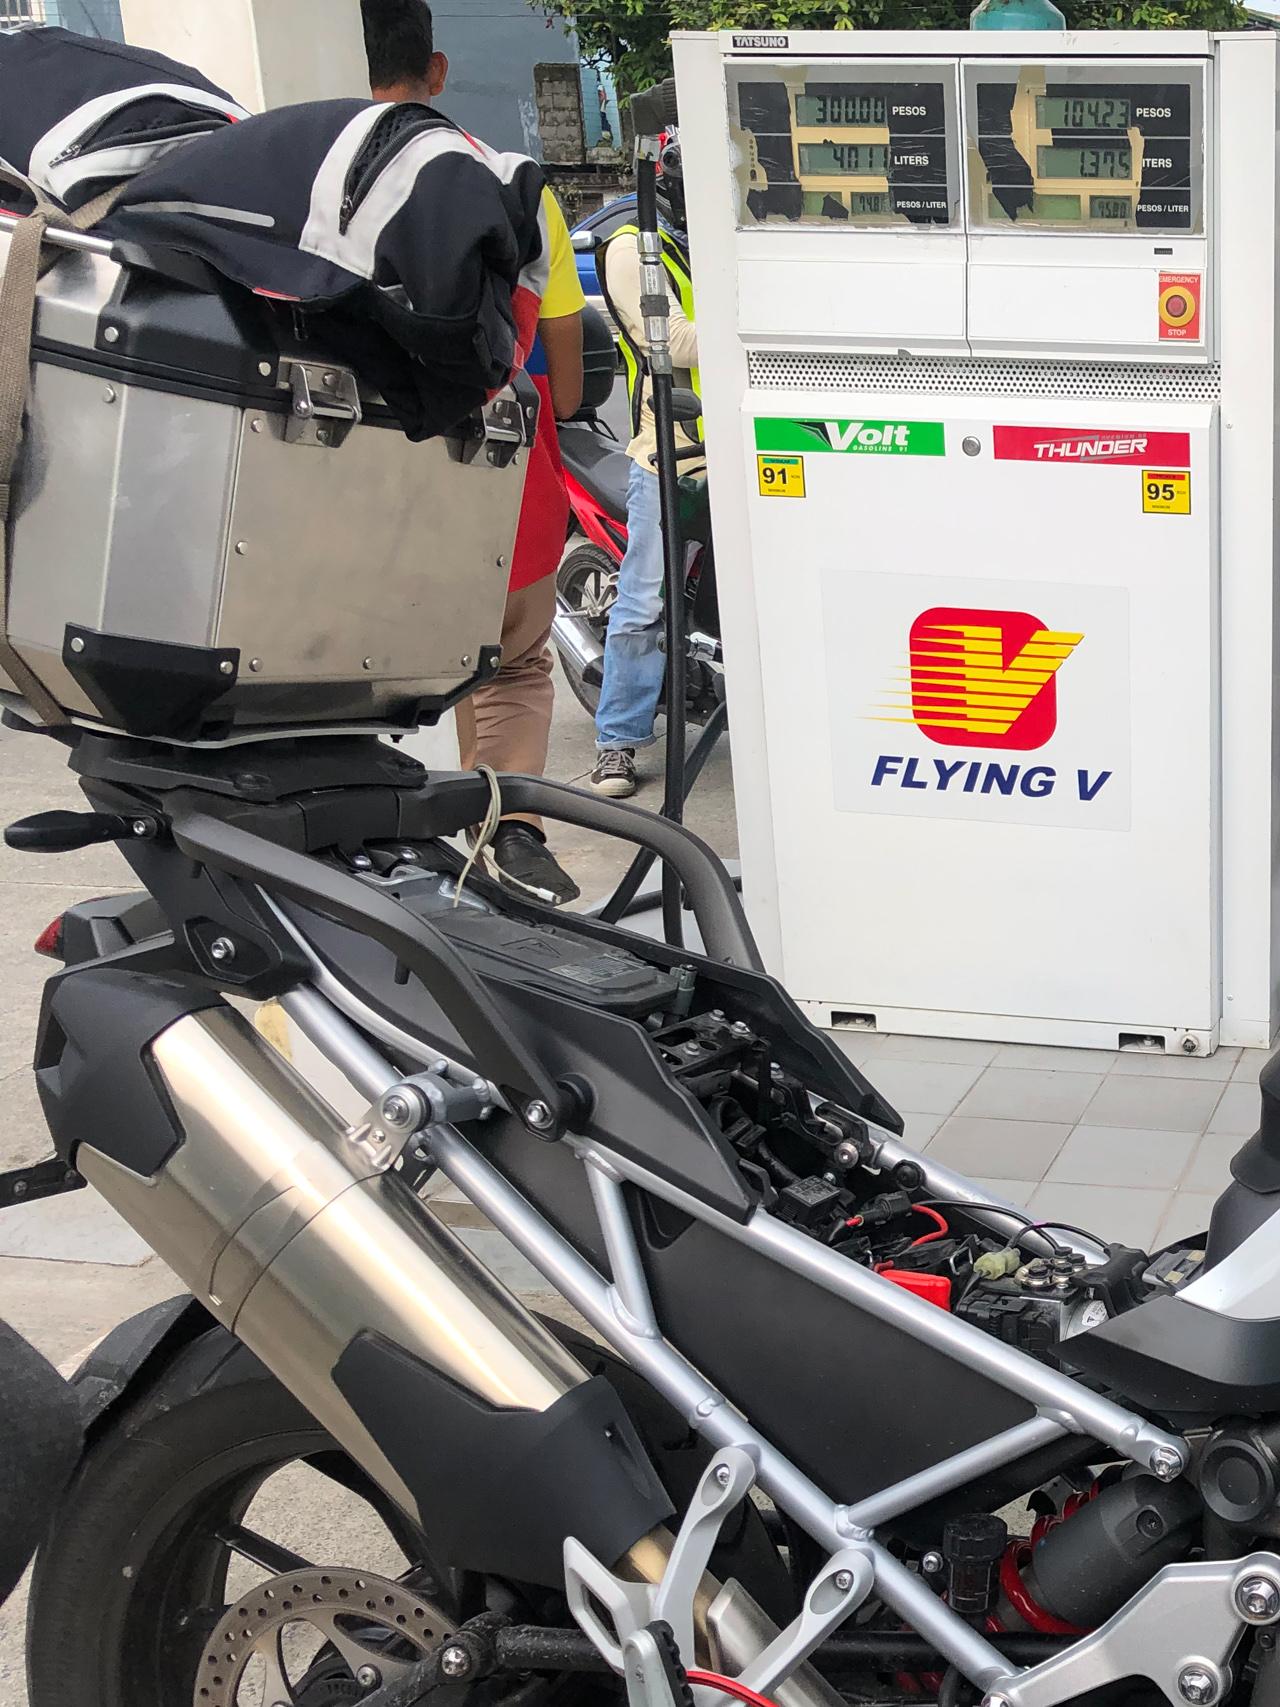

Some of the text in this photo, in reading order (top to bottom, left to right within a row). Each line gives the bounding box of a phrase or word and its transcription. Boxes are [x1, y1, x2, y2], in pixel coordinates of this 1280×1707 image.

[734, 36, 787, 48] TATSUNO
[892, 106, 927, 116] PESOS
[1136, 108, 1172, 118] PESOS
[894, 155, 929, 166] LITERS
[1142, 158, 1173, 168] ITERS
[896, 200, 921, 209] PESOS
[926, 201, 947, 209] LITER
[1137, 204, 1162, 212] PESOS
[1167, 205, 1189, 213] LITER
[1159, 275, 1199, 284] EMERGENCY
[1167, 328, 1187, 336] STOP
[824, 421, 911, 451] Volt
[852, 444, 892, 452] GASOLINE
[1033, 438, 1148, 458] THUNDER
[762, 467, 787, 485] 91
[1146, 483, 1175, 501] 95
[871, 755, 1113, 801] FLYING V
